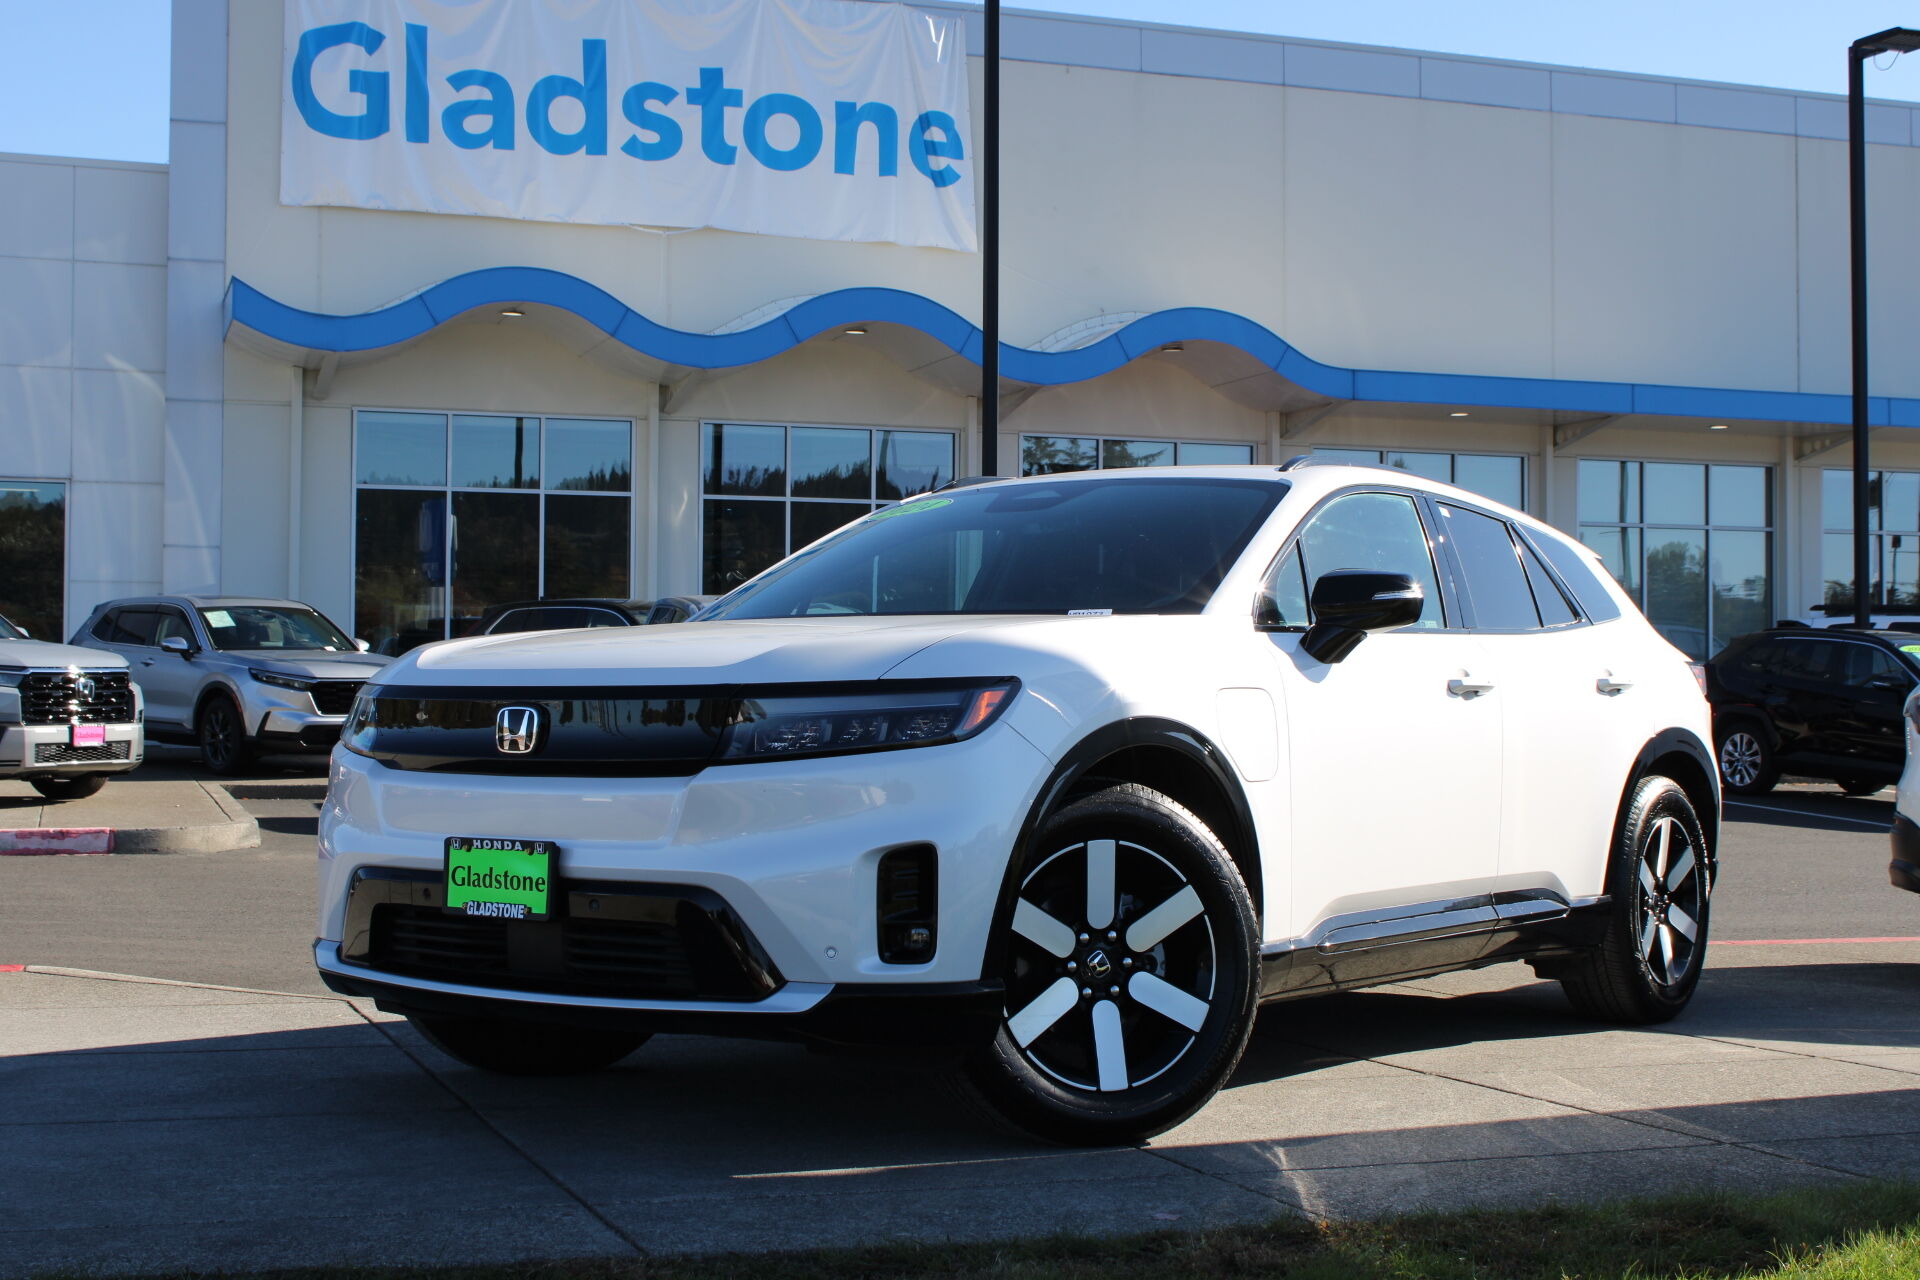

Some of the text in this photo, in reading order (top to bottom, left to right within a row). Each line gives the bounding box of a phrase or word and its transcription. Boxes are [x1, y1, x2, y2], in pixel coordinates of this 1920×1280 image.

[292, 21, 964, 188] Gladstone
[472, 839, 523, 851] HONDA
[451, 865, 546, 893] Gladstone
[466, 901, 525, 919] GLADSTONE
